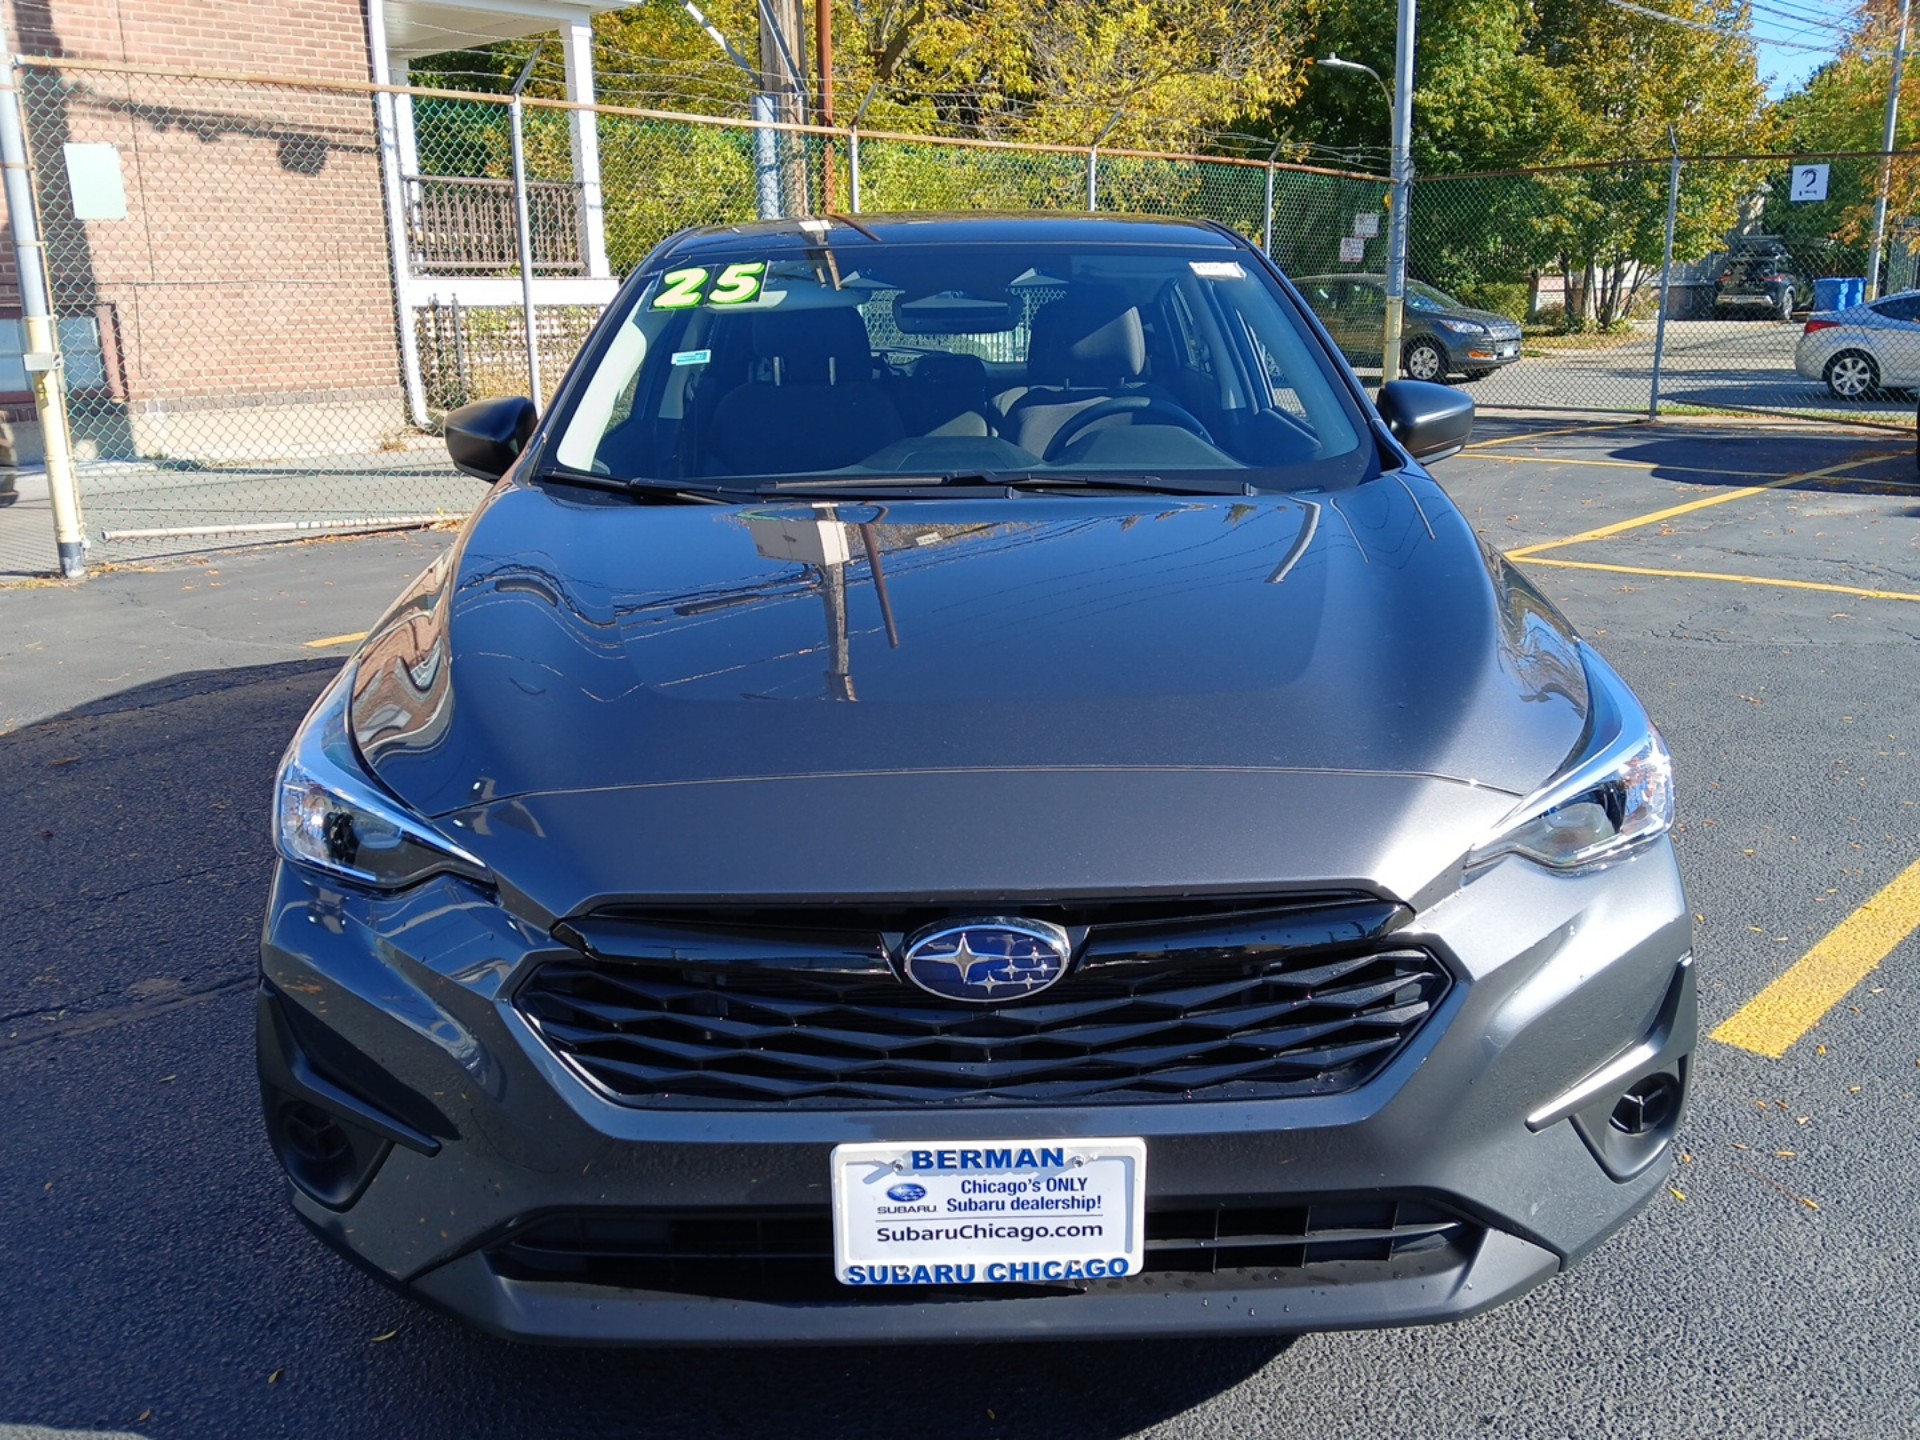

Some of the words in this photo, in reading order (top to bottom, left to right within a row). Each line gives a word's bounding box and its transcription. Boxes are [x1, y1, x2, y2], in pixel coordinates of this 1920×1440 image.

[653, 262, 765, 310] 25
[911, 1147, 1064, 1170] BERMAN
[960, 1178, 1041, 1196] Chicago's
[1046, 1177, 1088, 1192] ONLY
[877, 1204, 937, 1215] SUBARU
[946, 1197, 1005, 1212] Subaru
[1010, 1195, 1102, 1213] dealership!
[877, 1223, 1103, 1242] SubaruChicago.com
[847, 1263, 976, 1285] SUBARU
[987, 1257, 1130, 1283] CHICAGO
